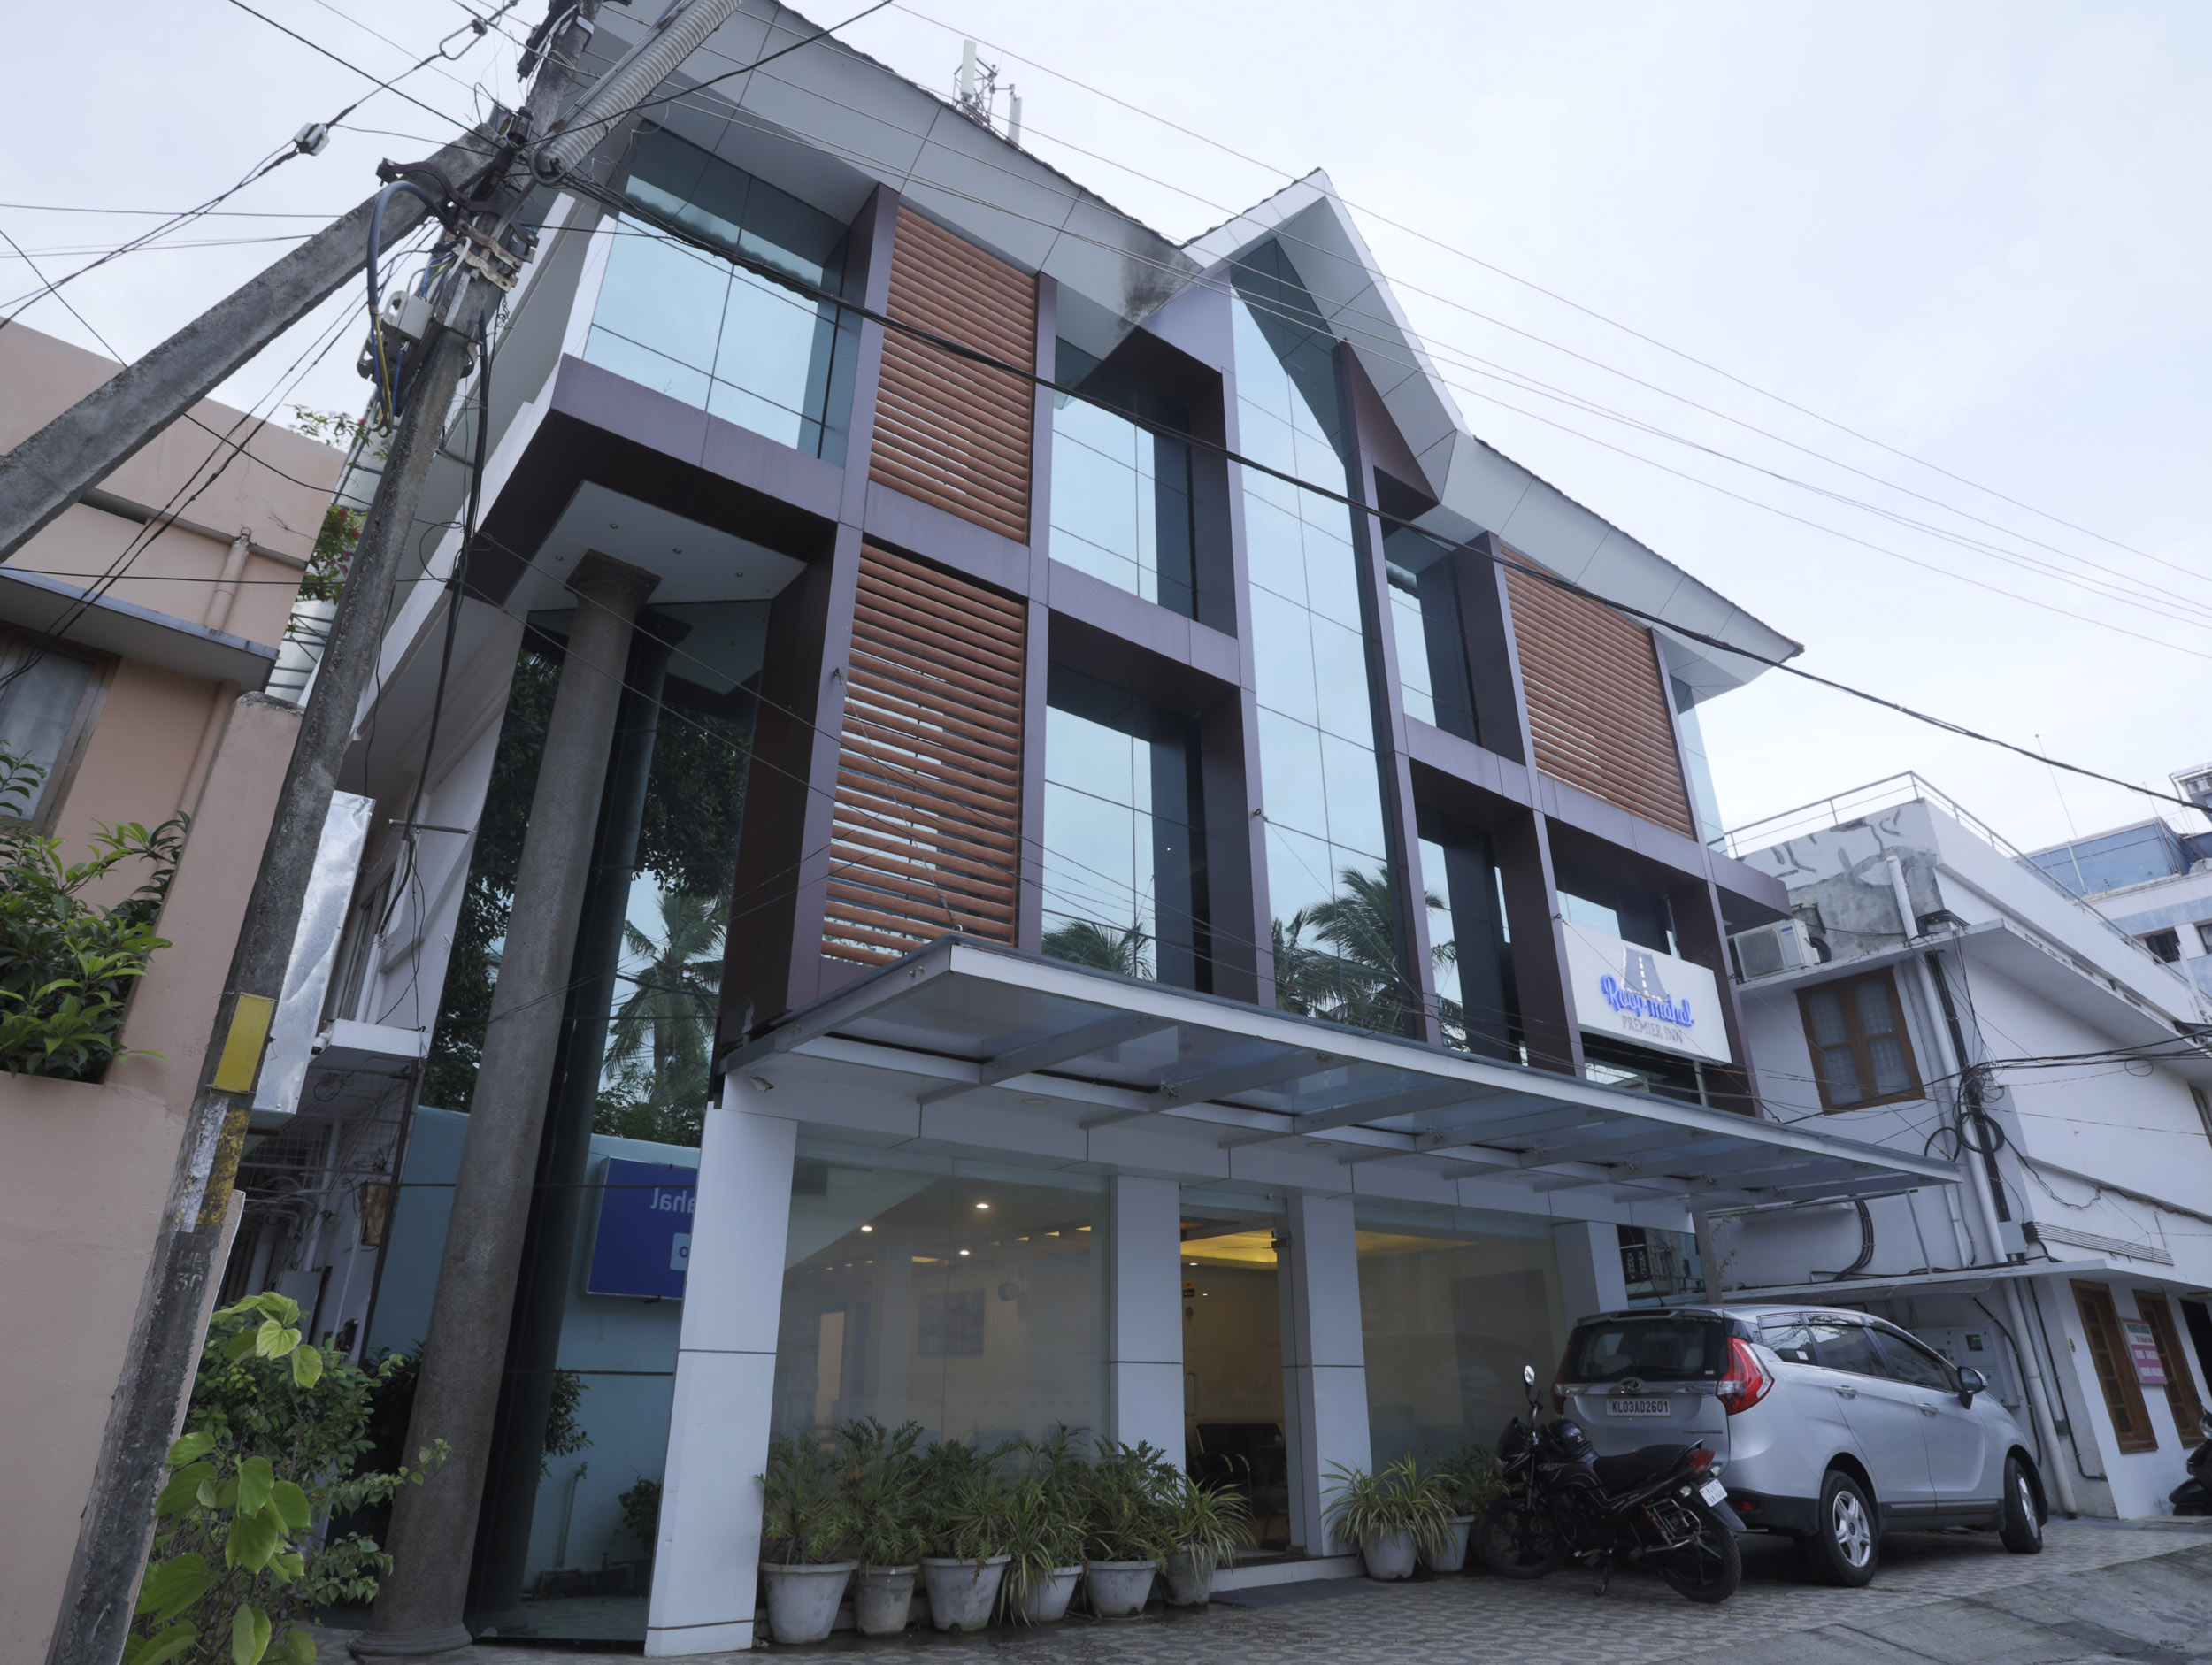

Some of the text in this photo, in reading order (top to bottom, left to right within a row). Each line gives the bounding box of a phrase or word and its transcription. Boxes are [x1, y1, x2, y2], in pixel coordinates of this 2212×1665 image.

[1622, 1016, 1683, 1044] PREMIER INN
[1612, 1400, 1668, 1413] KL03AD2601
